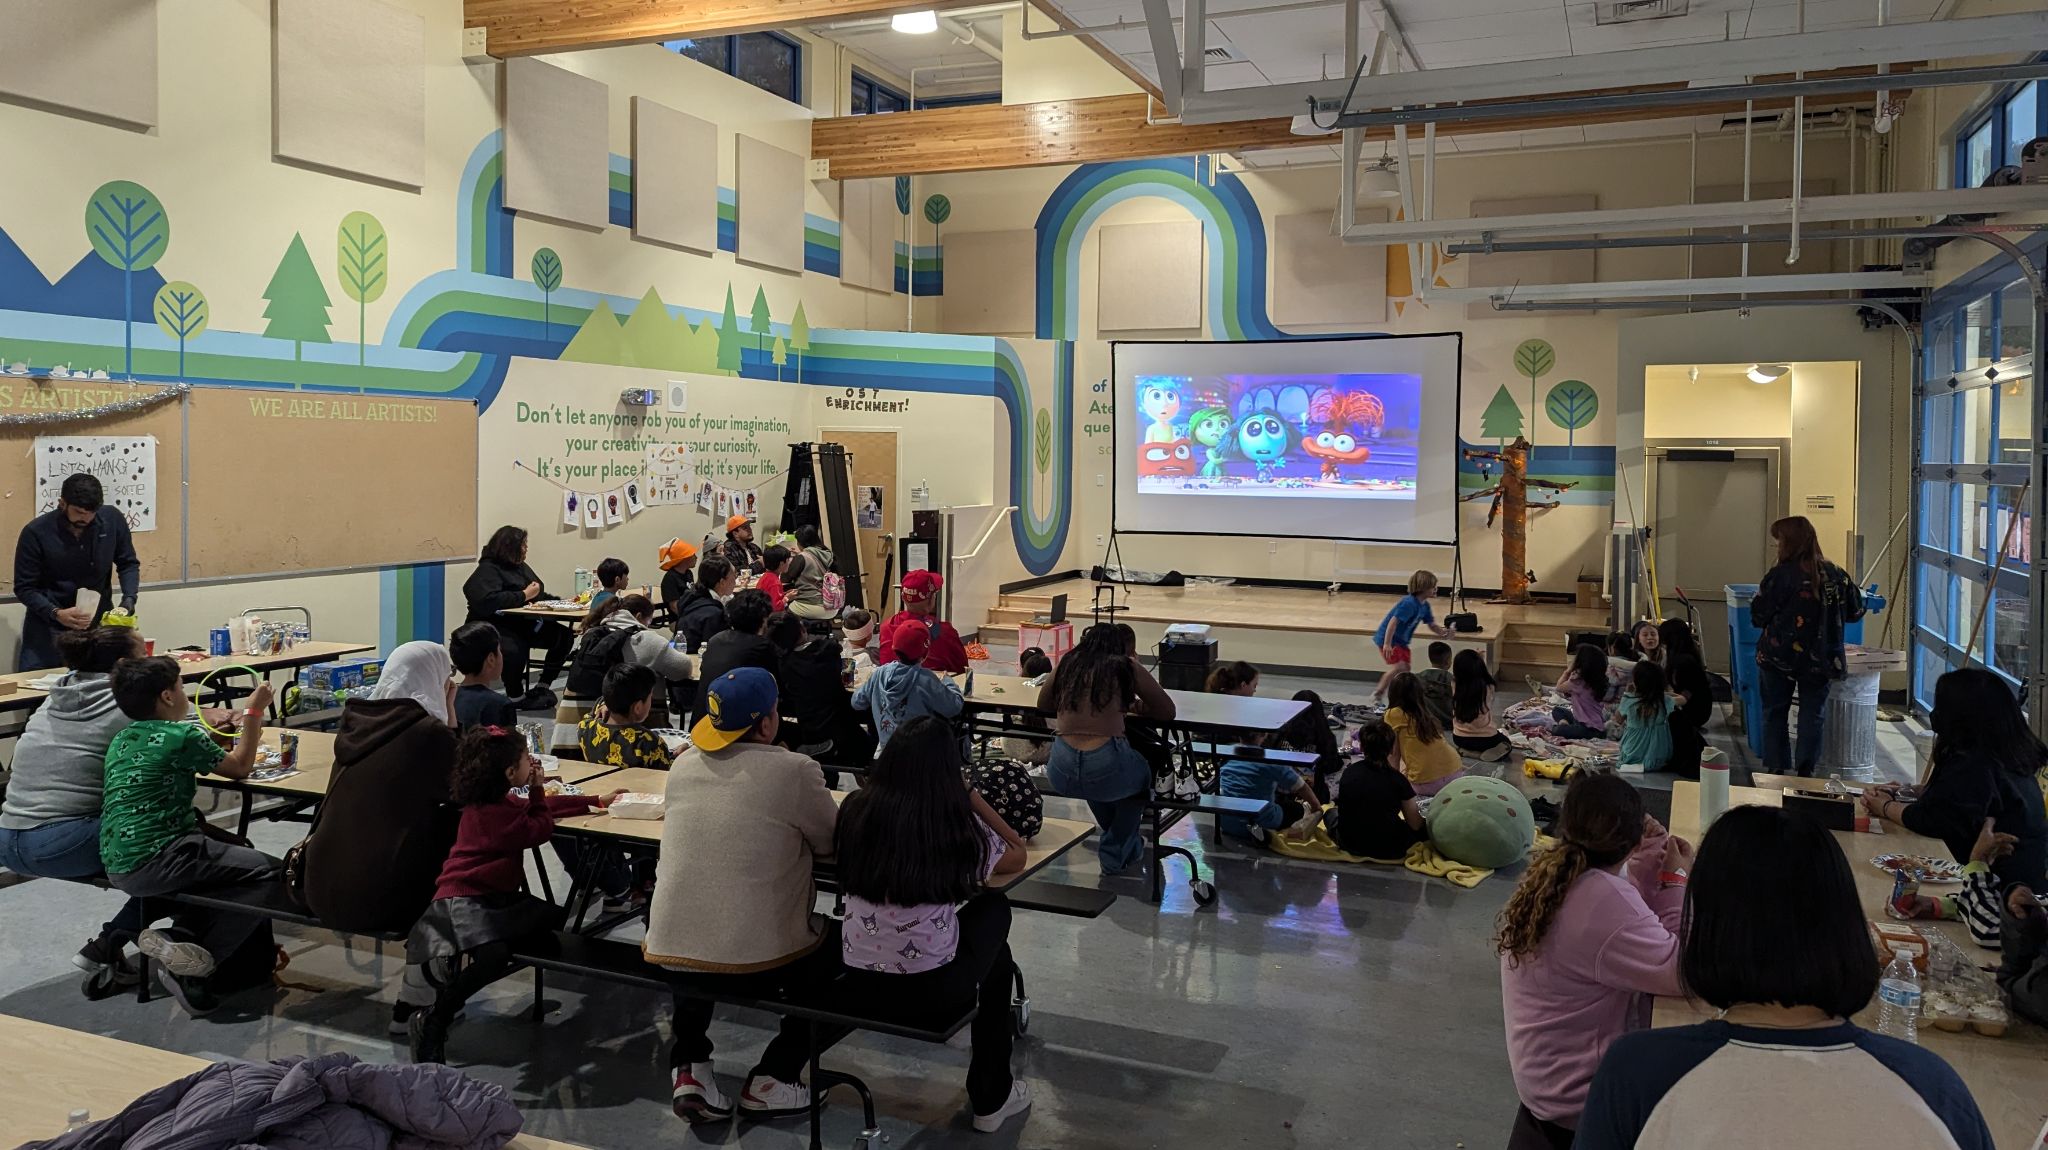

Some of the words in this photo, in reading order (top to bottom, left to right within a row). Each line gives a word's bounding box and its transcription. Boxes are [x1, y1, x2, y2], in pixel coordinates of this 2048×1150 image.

[1092, 379, 1108, 393] of
[249, 398, 283, 417] WE
[288, 399, 325, 419] ARE
[330, 401, 362, 420] ALL
[366, 403, 437, 422] ARTISTS!
[826, 396, 910, 413] ENRICHMENT!
[516, 401, 561, 424] Don't
[566, 405, 585, 425] let
[589, 413, 638, 432] anyone
[641, 410, 661, 428] rob
[665, 415, 686, 434] you
[689, 412, 701, 429] of
[703, 418, 727, 435] your
[730, 414, 790, 437] imagination,
[566, 438, 598, 457] your
[602, 434, 663, 452] creativ
[713, 437, 761, 458] curiosity.
[537, 457, 561, 478] It's
[565, 464, 597, 483] your
[601, 458, 637, 483] place
[717, 458, 733, 475] it's
[735, 465, 758, 480] your
[760, 459, 779, 475] life.
